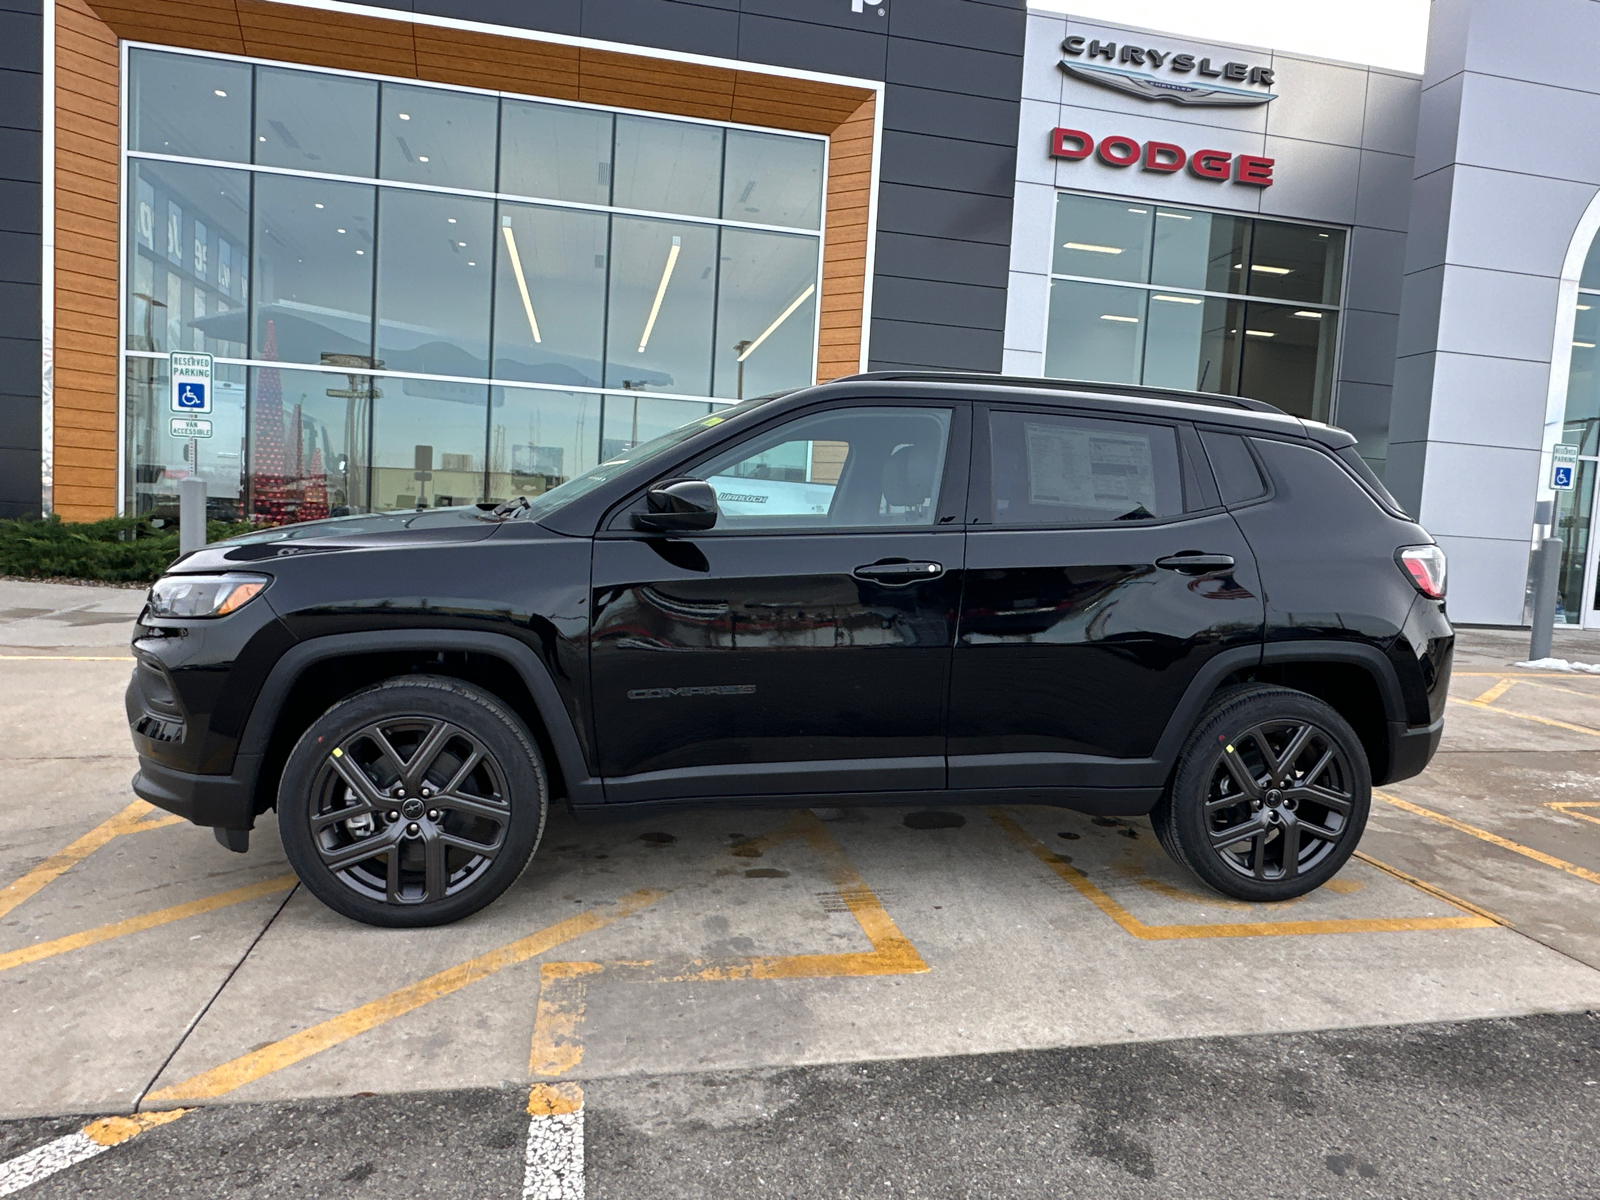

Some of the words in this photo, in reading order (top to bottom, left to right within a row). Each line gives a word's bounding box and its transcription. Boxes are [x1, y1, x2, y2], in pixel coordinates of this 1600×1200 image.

[1061, 35, 1276, 85] CHRYSLER
[1049, 126, 1276, 188] DODGE
[173, 356, 210, 368] RESERVED
[173, 367, 210, 377] PARKING
[173, 428, 210, 436] ACCESSIBLE
[718, 492, 769, 504] WARLOCK
[627, 685, 756, 699] COMPASS
